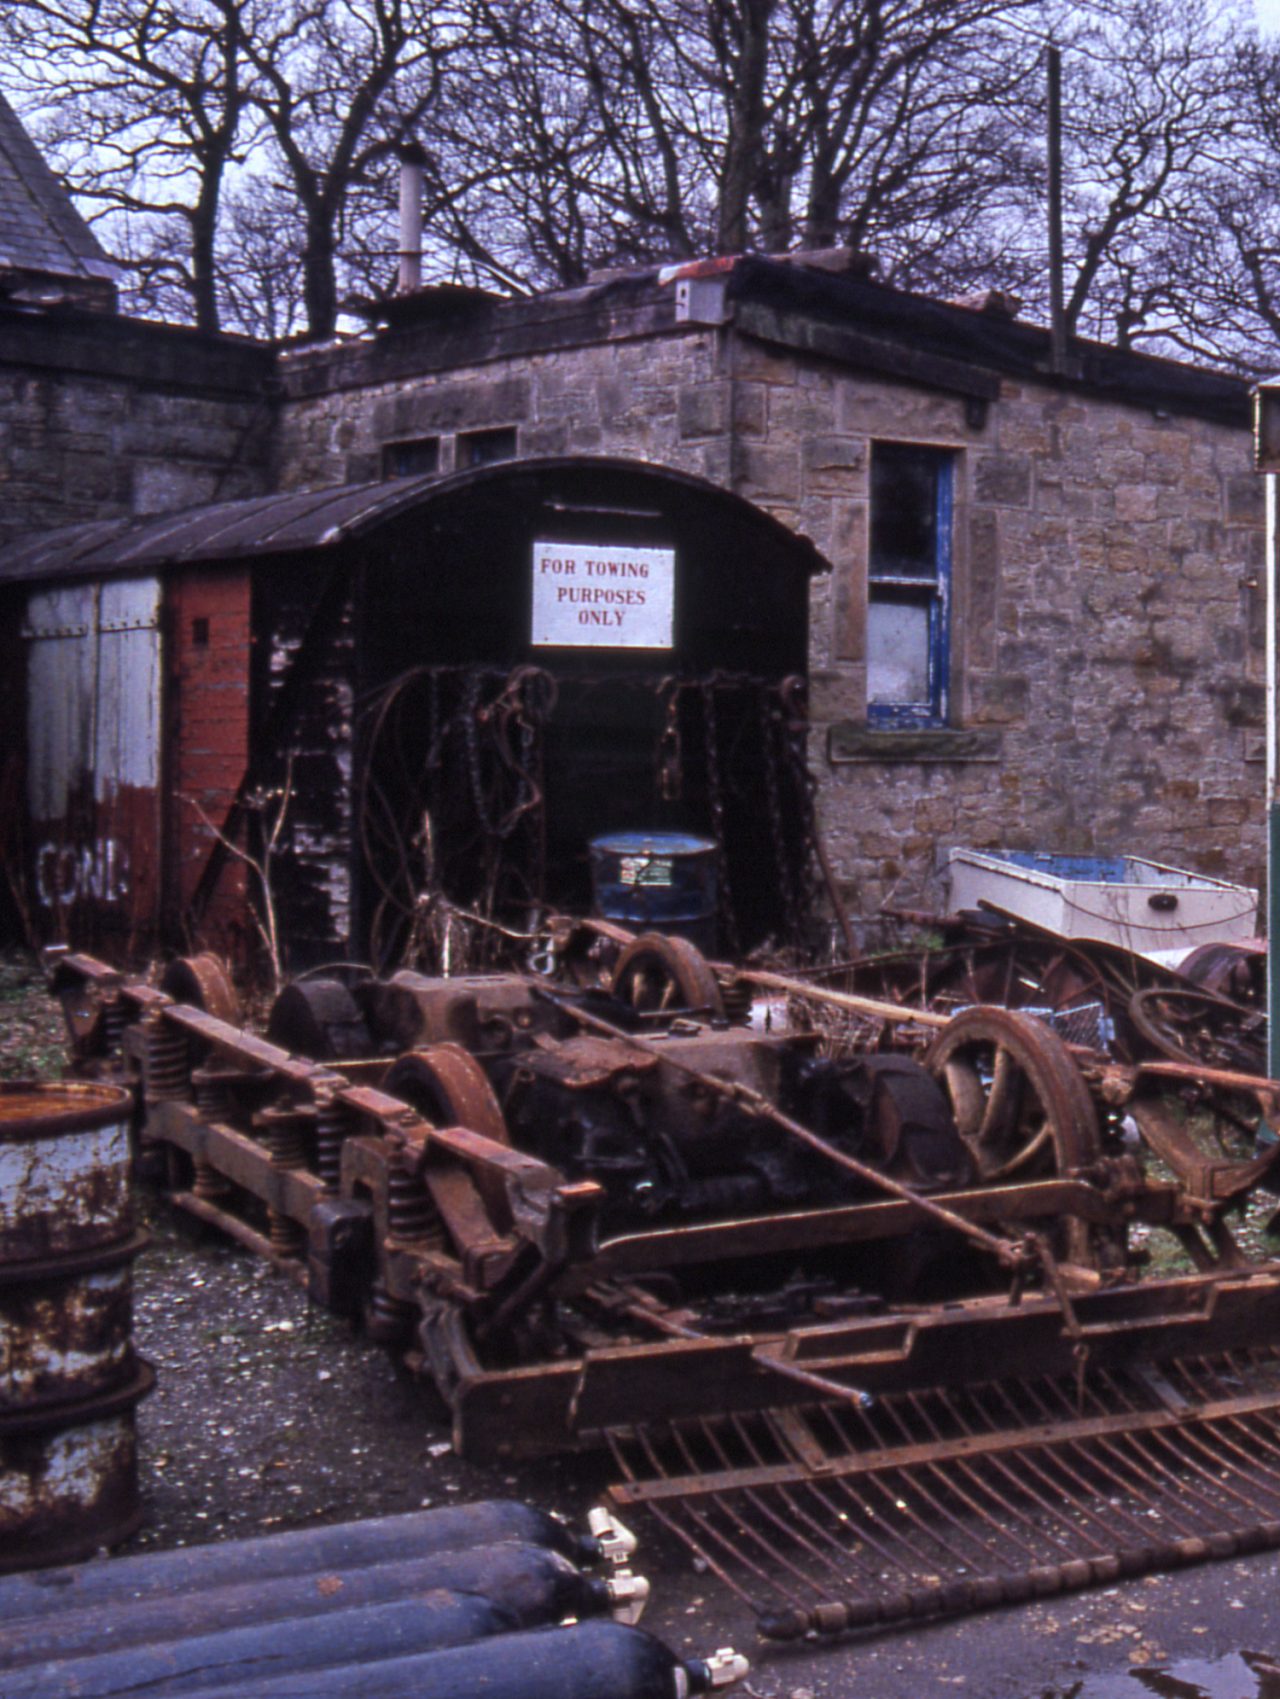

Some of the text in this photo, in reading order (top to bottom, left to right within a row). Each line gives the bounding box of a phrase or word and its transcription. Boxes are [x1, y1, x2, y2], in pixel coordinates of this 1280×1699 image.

[540, 558, 649, 578] FOR TOWING
[557, 587, 646, 605] PURPOSES
[578, 610, 625, 626] ONLY
